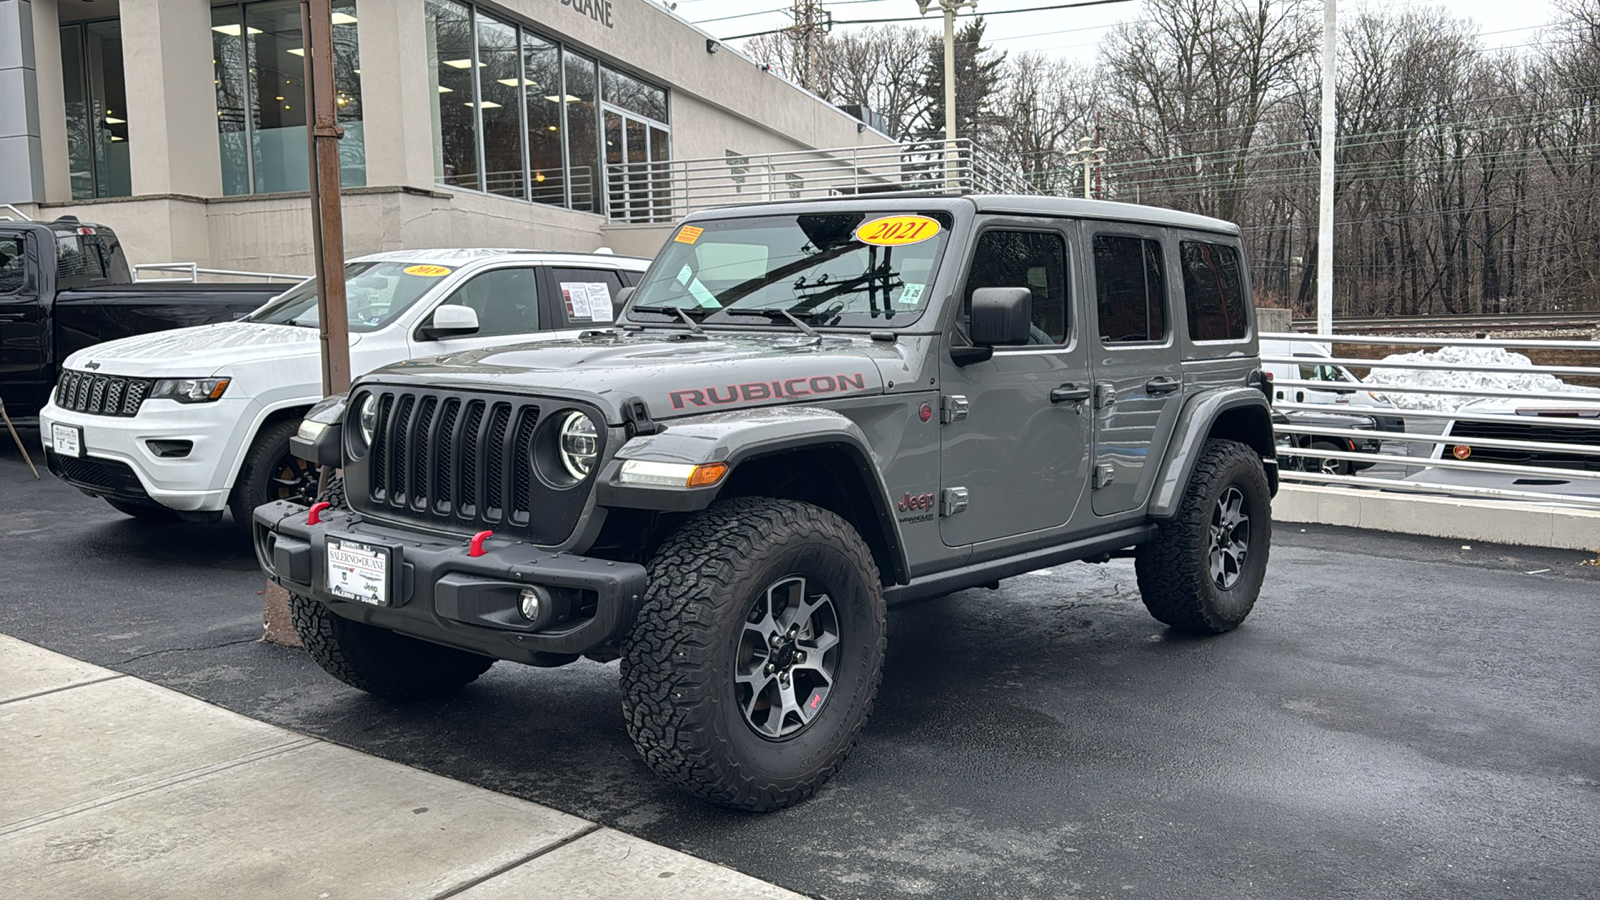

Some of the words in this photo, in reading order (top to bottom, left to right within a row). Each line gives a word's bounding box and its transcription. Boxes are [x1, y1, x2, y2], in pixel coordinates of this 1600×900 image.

[867, 221, 929, 240] 2021
[669, 373, 865, 410] RUBICON
[899, 492, 935, 513] Jeep
[330, 550, 359, 565] SALERNO
[361, 556, 385, 571] DUANE
[363, 582, 378, 593] Jeep
